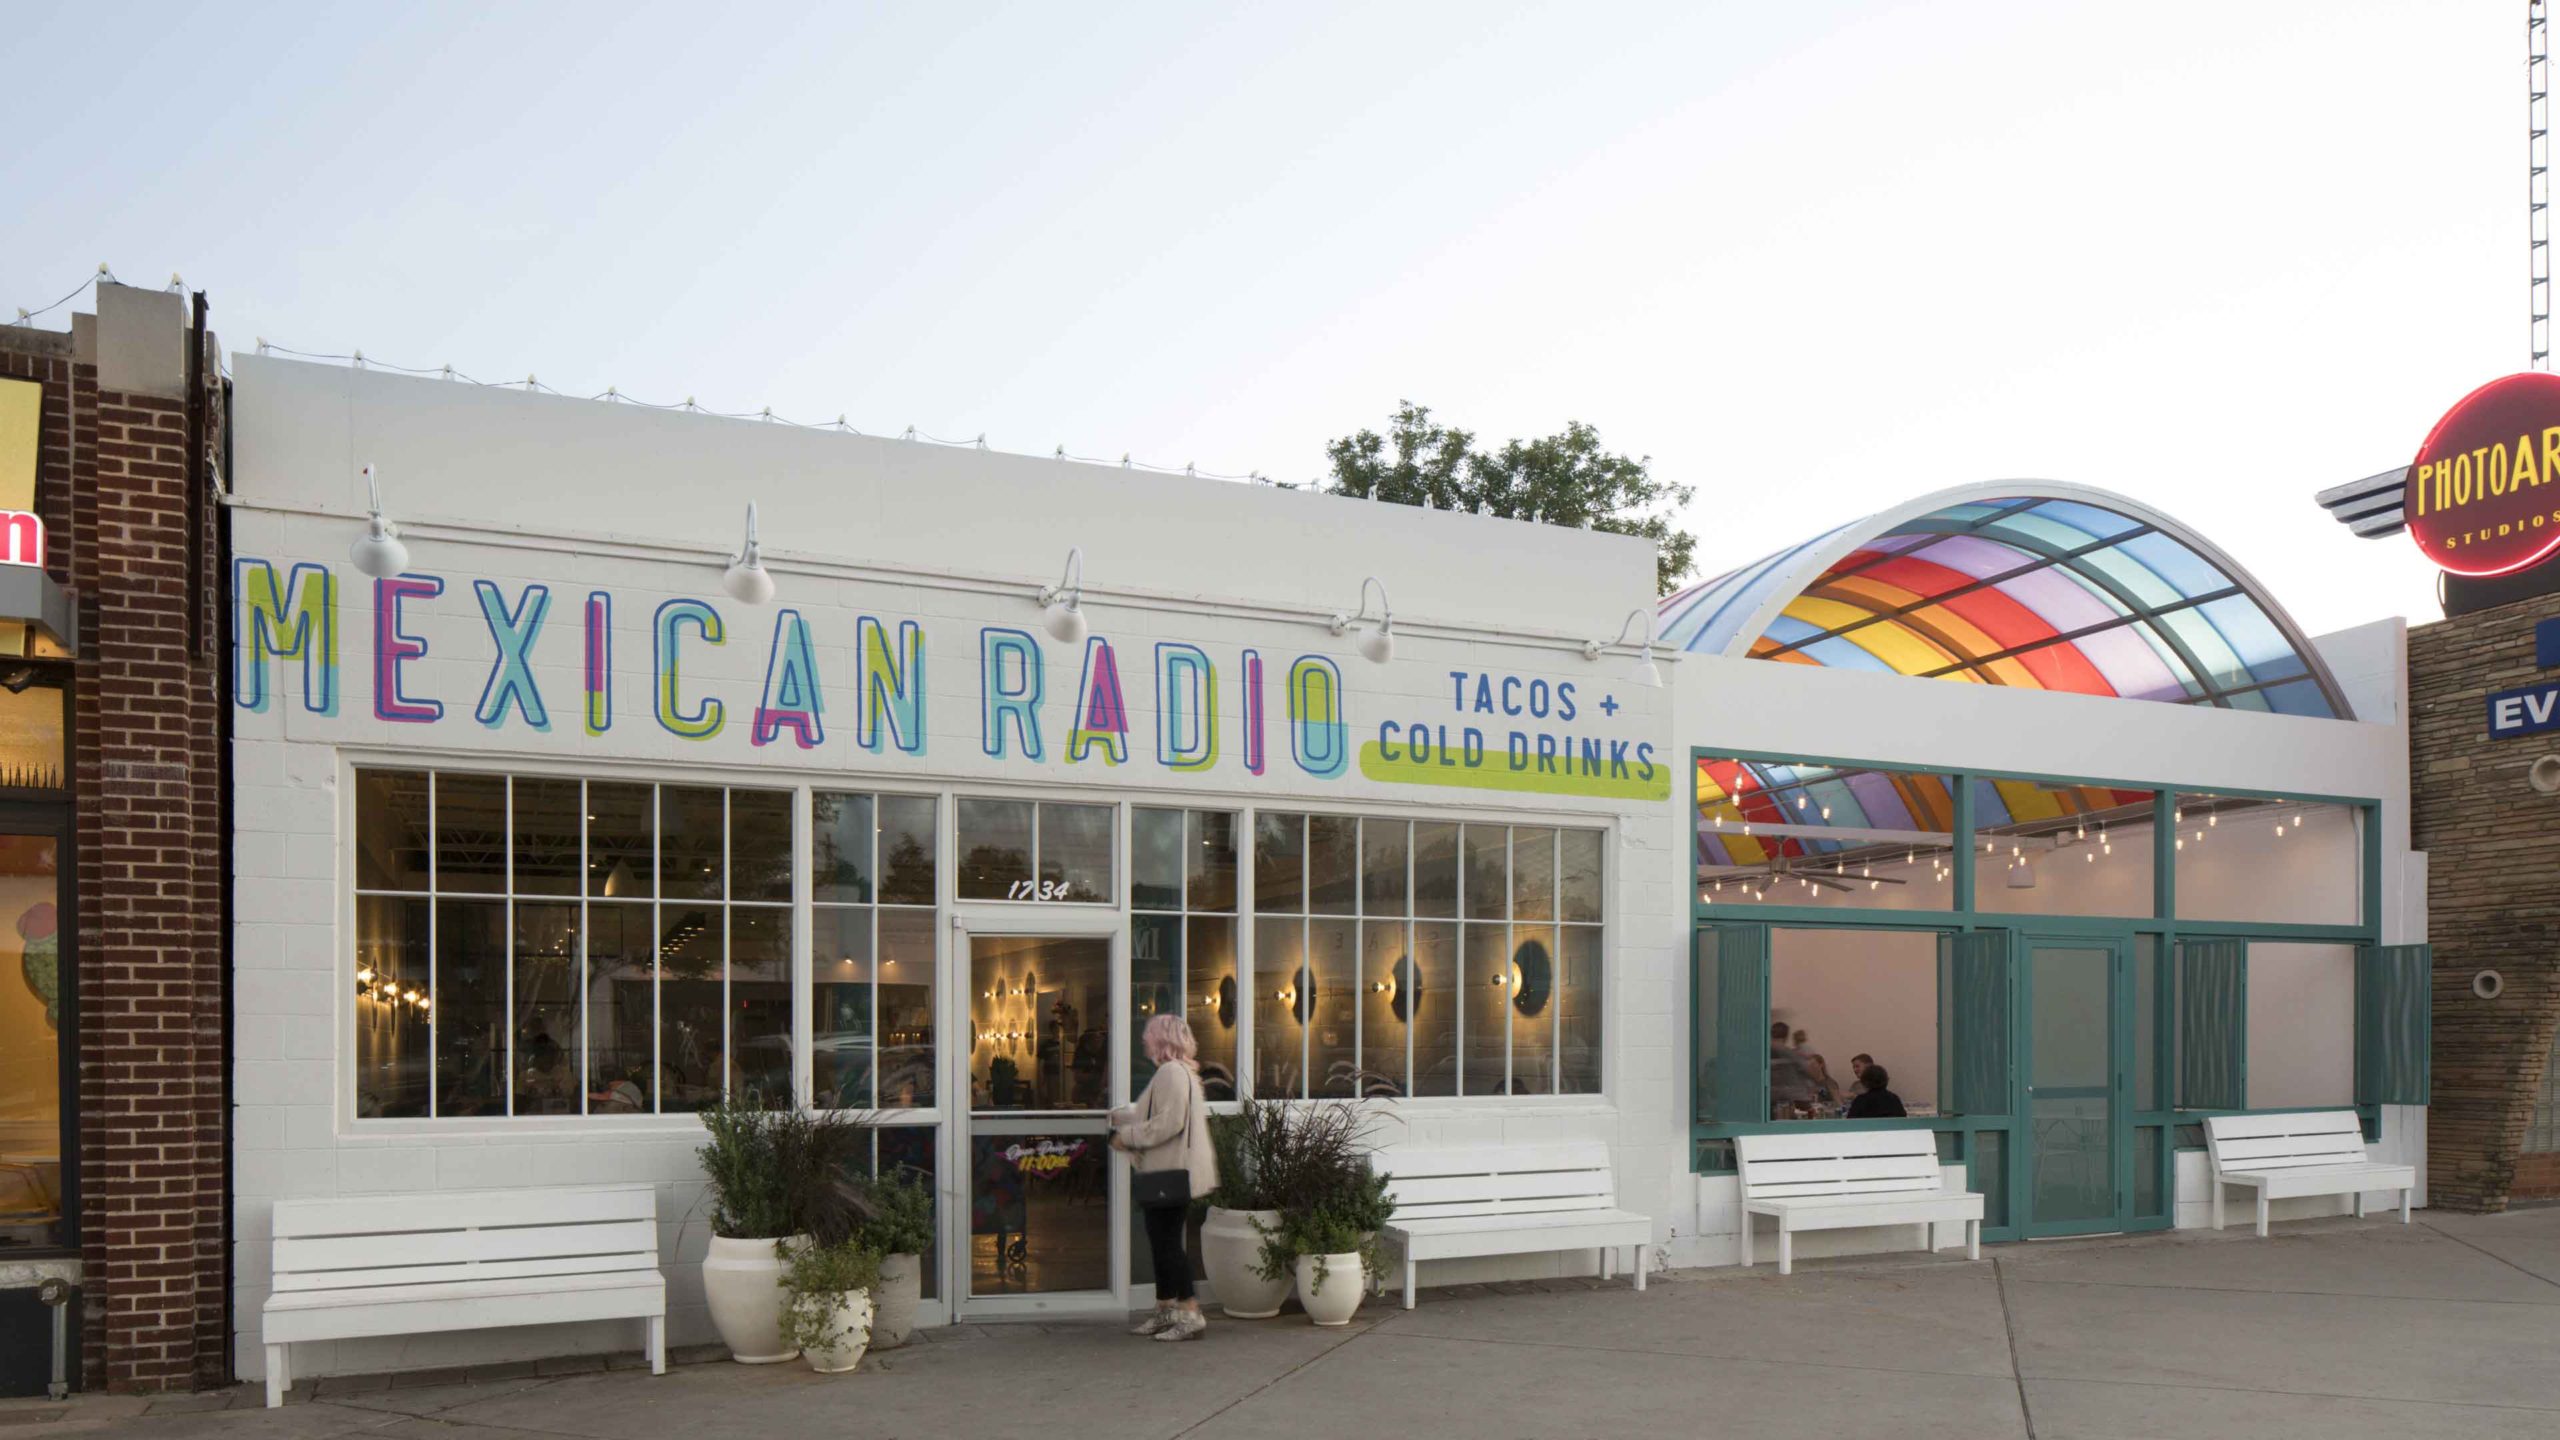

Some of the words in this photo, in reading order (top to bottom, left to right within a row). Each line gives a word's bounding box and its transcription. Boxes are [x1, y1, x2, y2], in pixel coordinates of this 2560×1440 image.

[2446, 510, 2560, 550] STUDIOS
[234, 557, 927, 757] MEXICAN
[980, 627, 1349, 780] RADIO
[1450, 671, 1576, 722] TACOS
[1379, 719, 1484, 769] COLD
[1508, 730, 1655, 782] DRINKS
[1007, 879, 1071, 901] 1734
